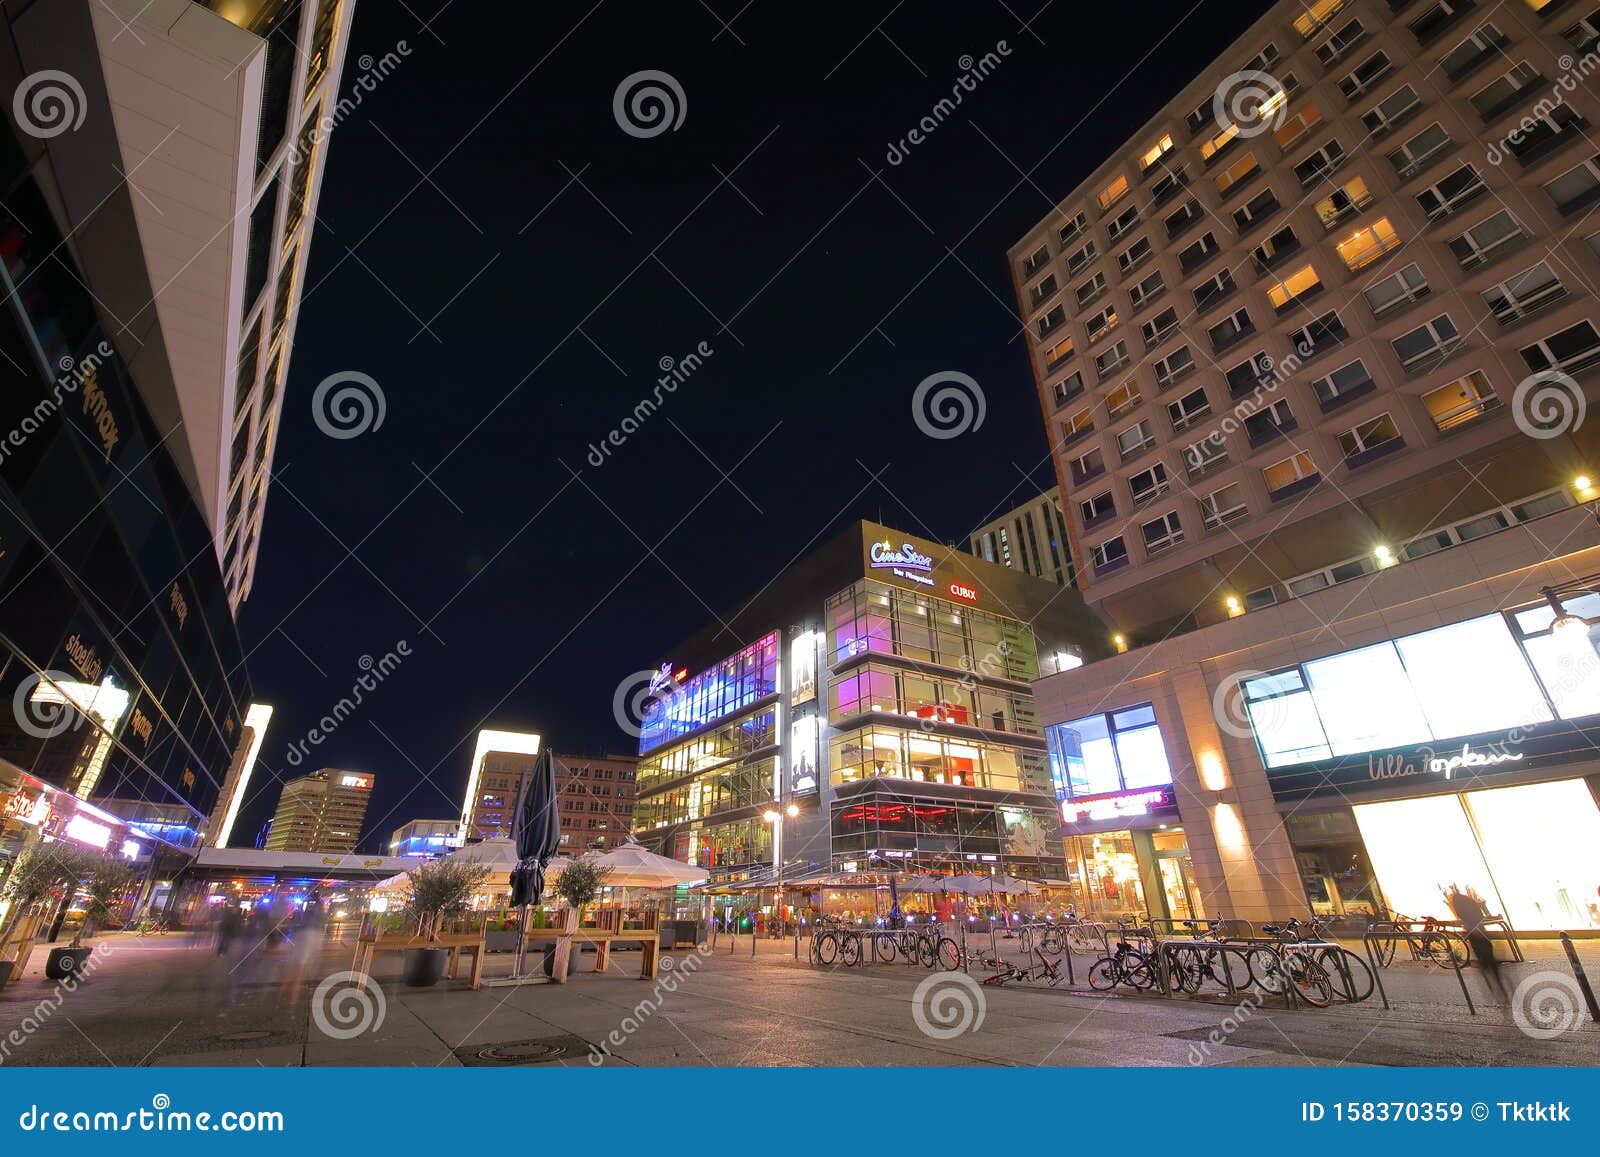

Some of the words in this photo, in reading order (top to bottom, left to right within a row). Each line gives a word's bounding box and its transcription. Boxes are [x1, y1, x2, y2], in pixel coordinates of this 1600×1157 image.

[870, 540, 932, 570] CineStar
[950, 584, 977, 601] CUBIX
[1368, 753, 1418, 780] Ulla
[1415, 742, 1523, 781] Popken
